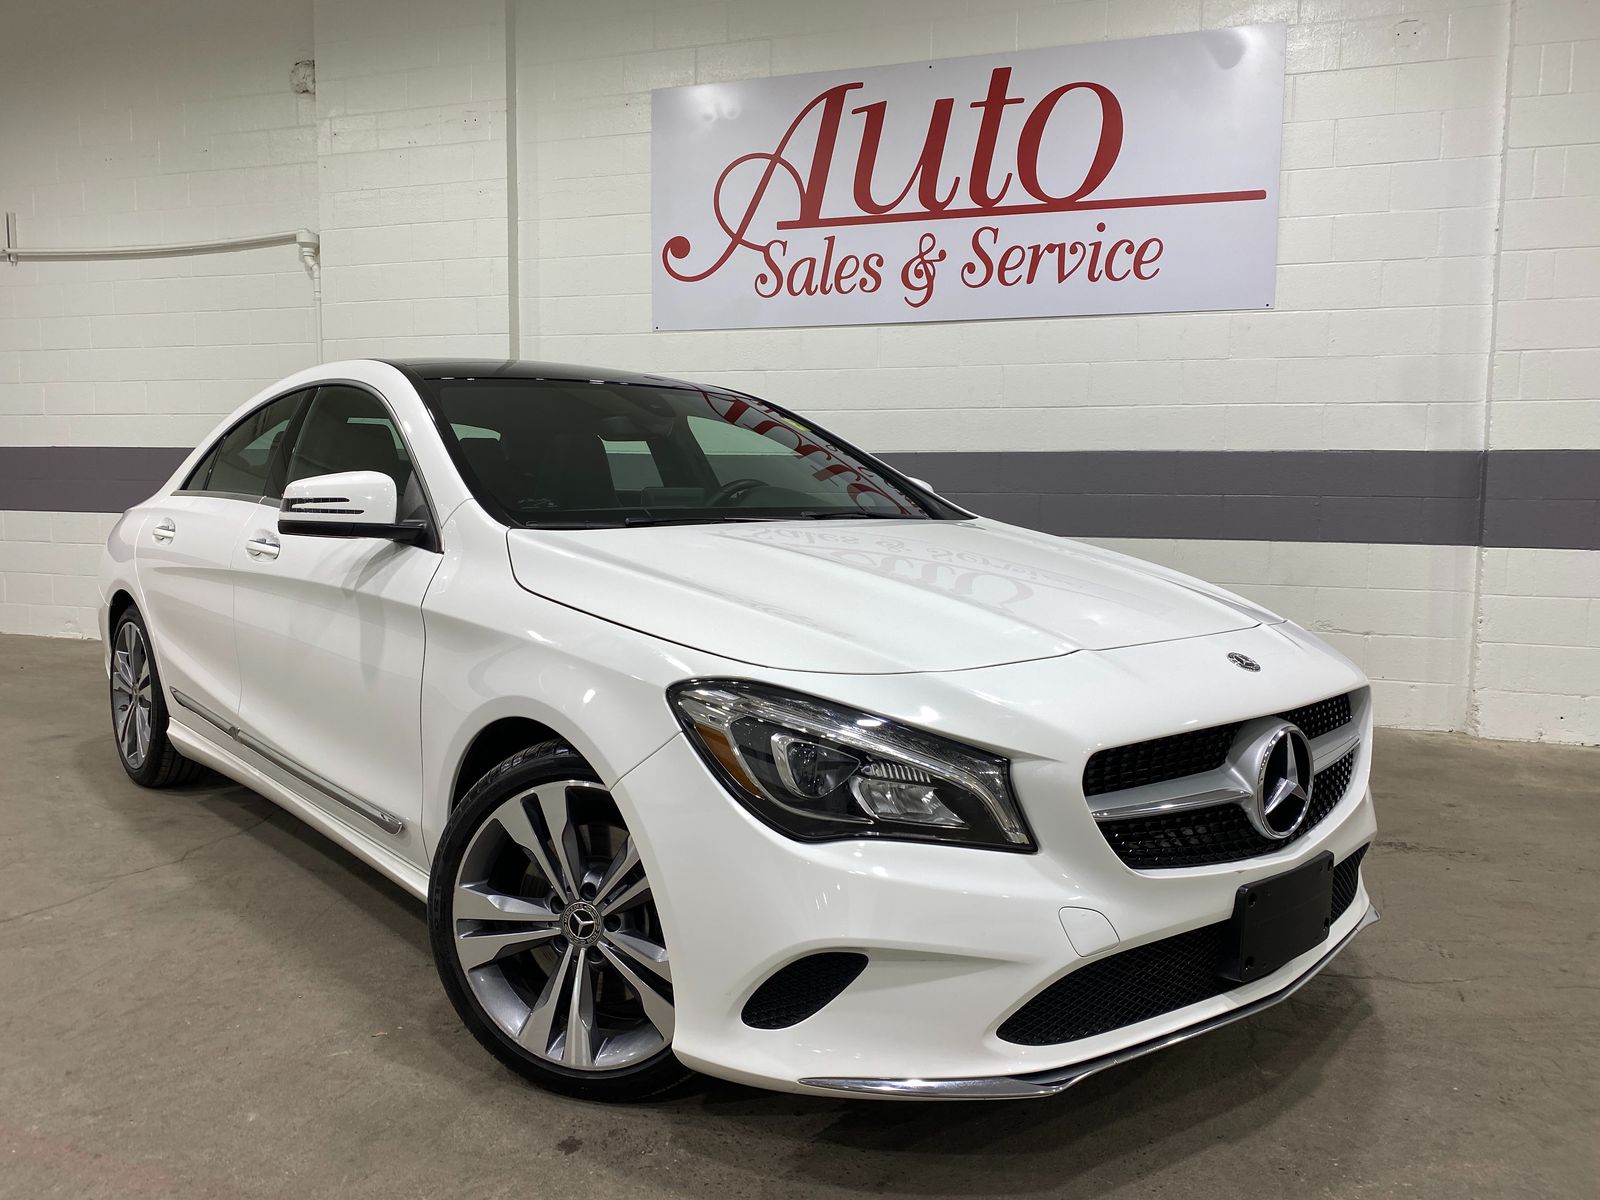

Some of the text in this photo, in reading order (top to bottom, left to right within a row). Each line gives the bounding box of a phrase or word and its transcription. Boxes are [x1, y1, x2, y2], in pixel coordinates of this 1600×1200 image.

[662, 66, 1124, 283] Auto
[754, 222, 1164, 308] Sales & Service
